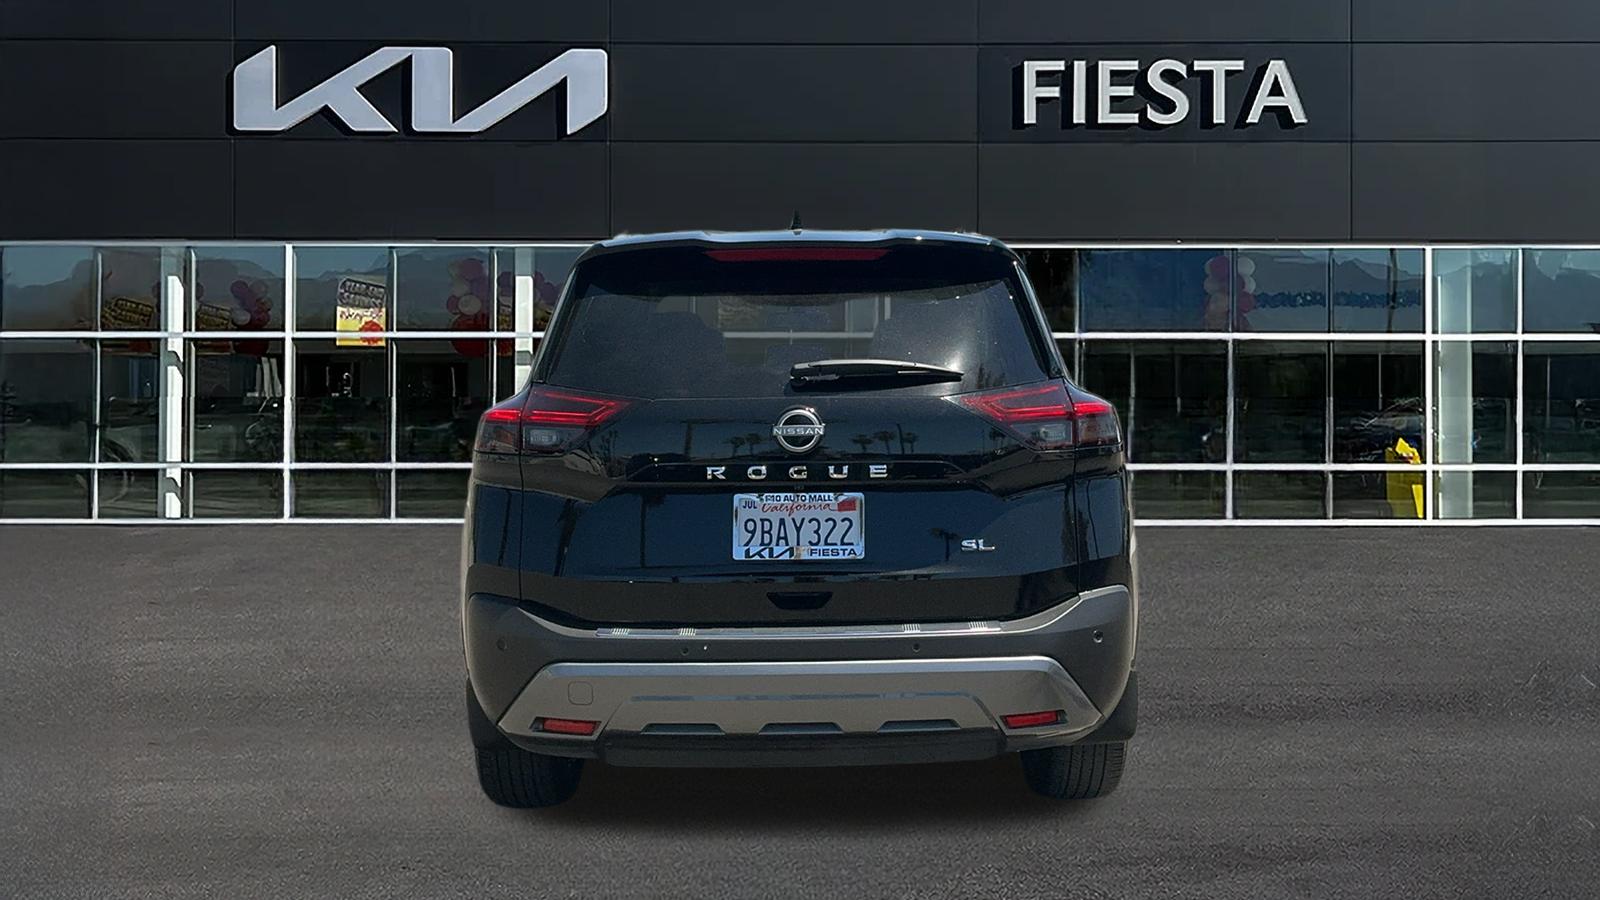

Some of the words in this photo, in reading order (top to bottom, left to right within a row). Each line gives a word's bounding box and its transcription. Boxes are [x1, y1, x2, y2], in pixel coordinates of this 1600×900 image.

[233, 45, 609, 135] KIA
[1023, 58, 1308, 125] FIESTA
[772, 426, 825, 436] NISSAN
[706, 464, 889, 480] ROGUE
[743, 500, 758, 509] JUL
[783, 494, 807, 503] AUTO
[808, 494, 833, 503] MALL
[761, 502, 834, 517] California
[743, 517, 855, 547] 9BAY322
[961, 539, 996, 551] SL
[744, 546, 795, 559] KIA
[809, 548, 858, 557] FIESTA
